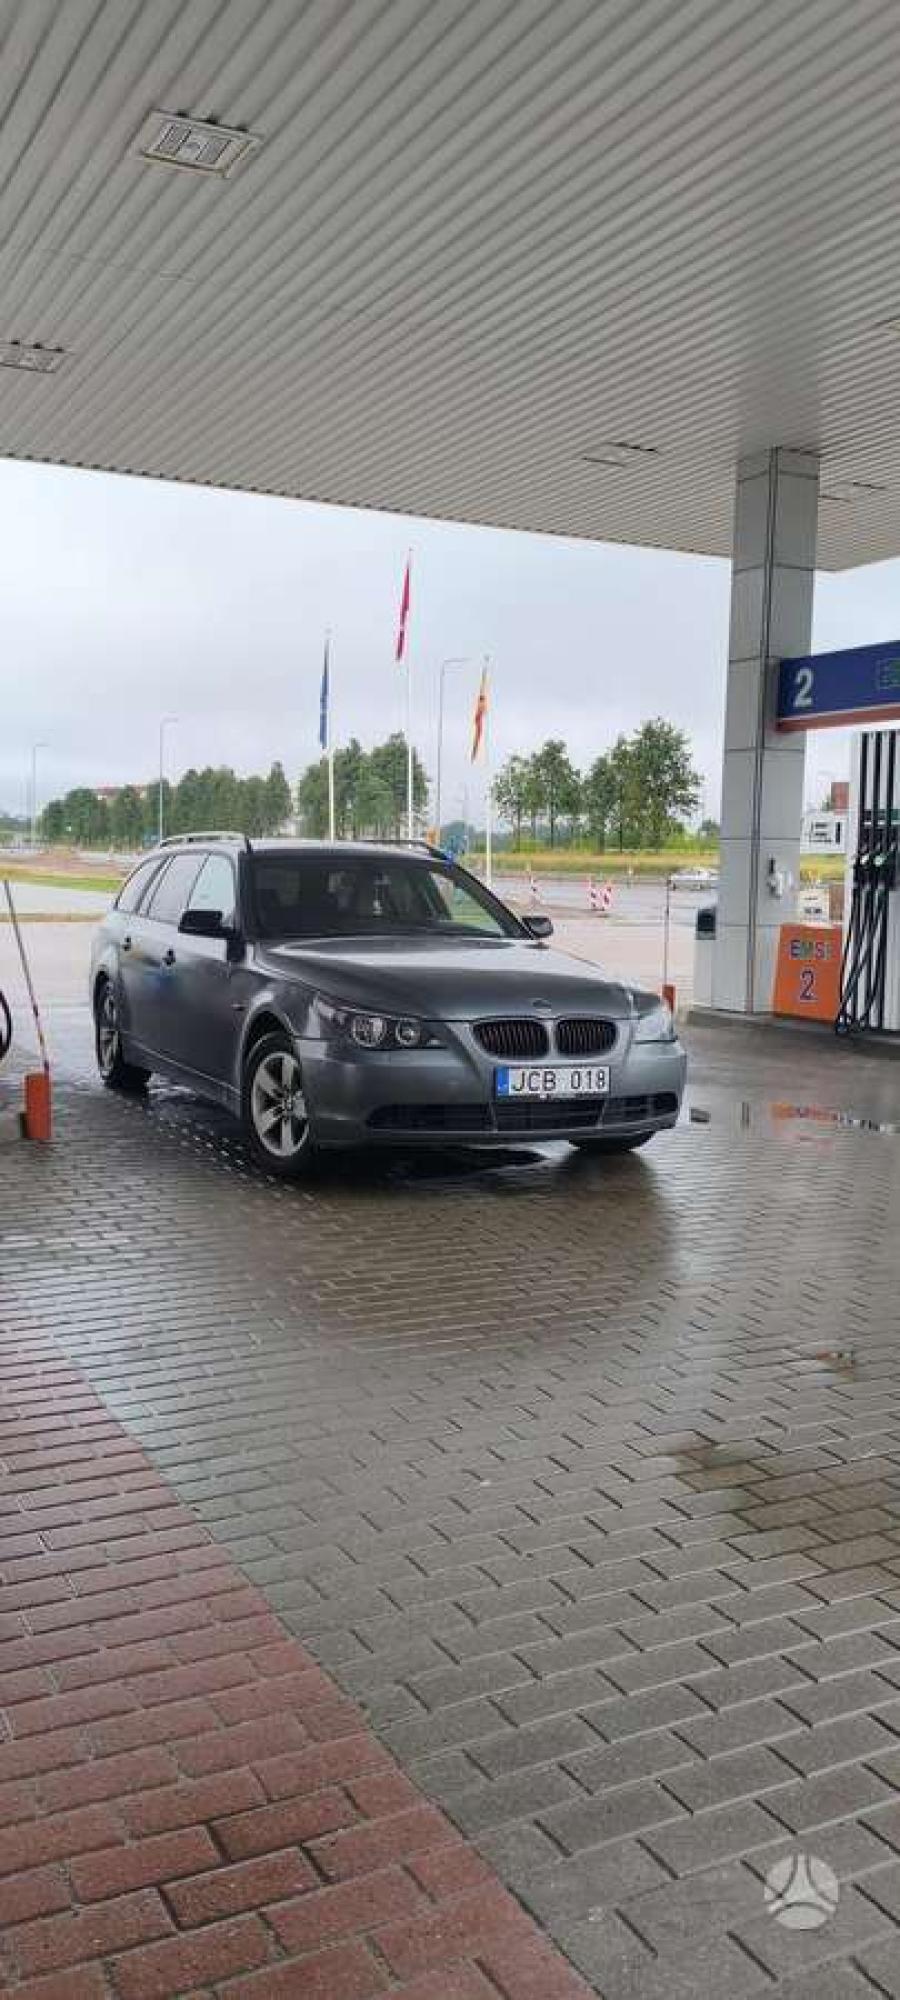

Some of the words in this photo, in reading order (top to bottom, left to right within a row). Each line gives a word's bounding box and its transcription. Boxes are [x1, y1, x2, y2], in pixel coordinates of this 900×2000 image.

[794, 668, 813, 707] 2
[801, 970, 815, 999] 2
[511, 1070, 556, 1092] JCB
[570, 1070, 605, 1091] 018
